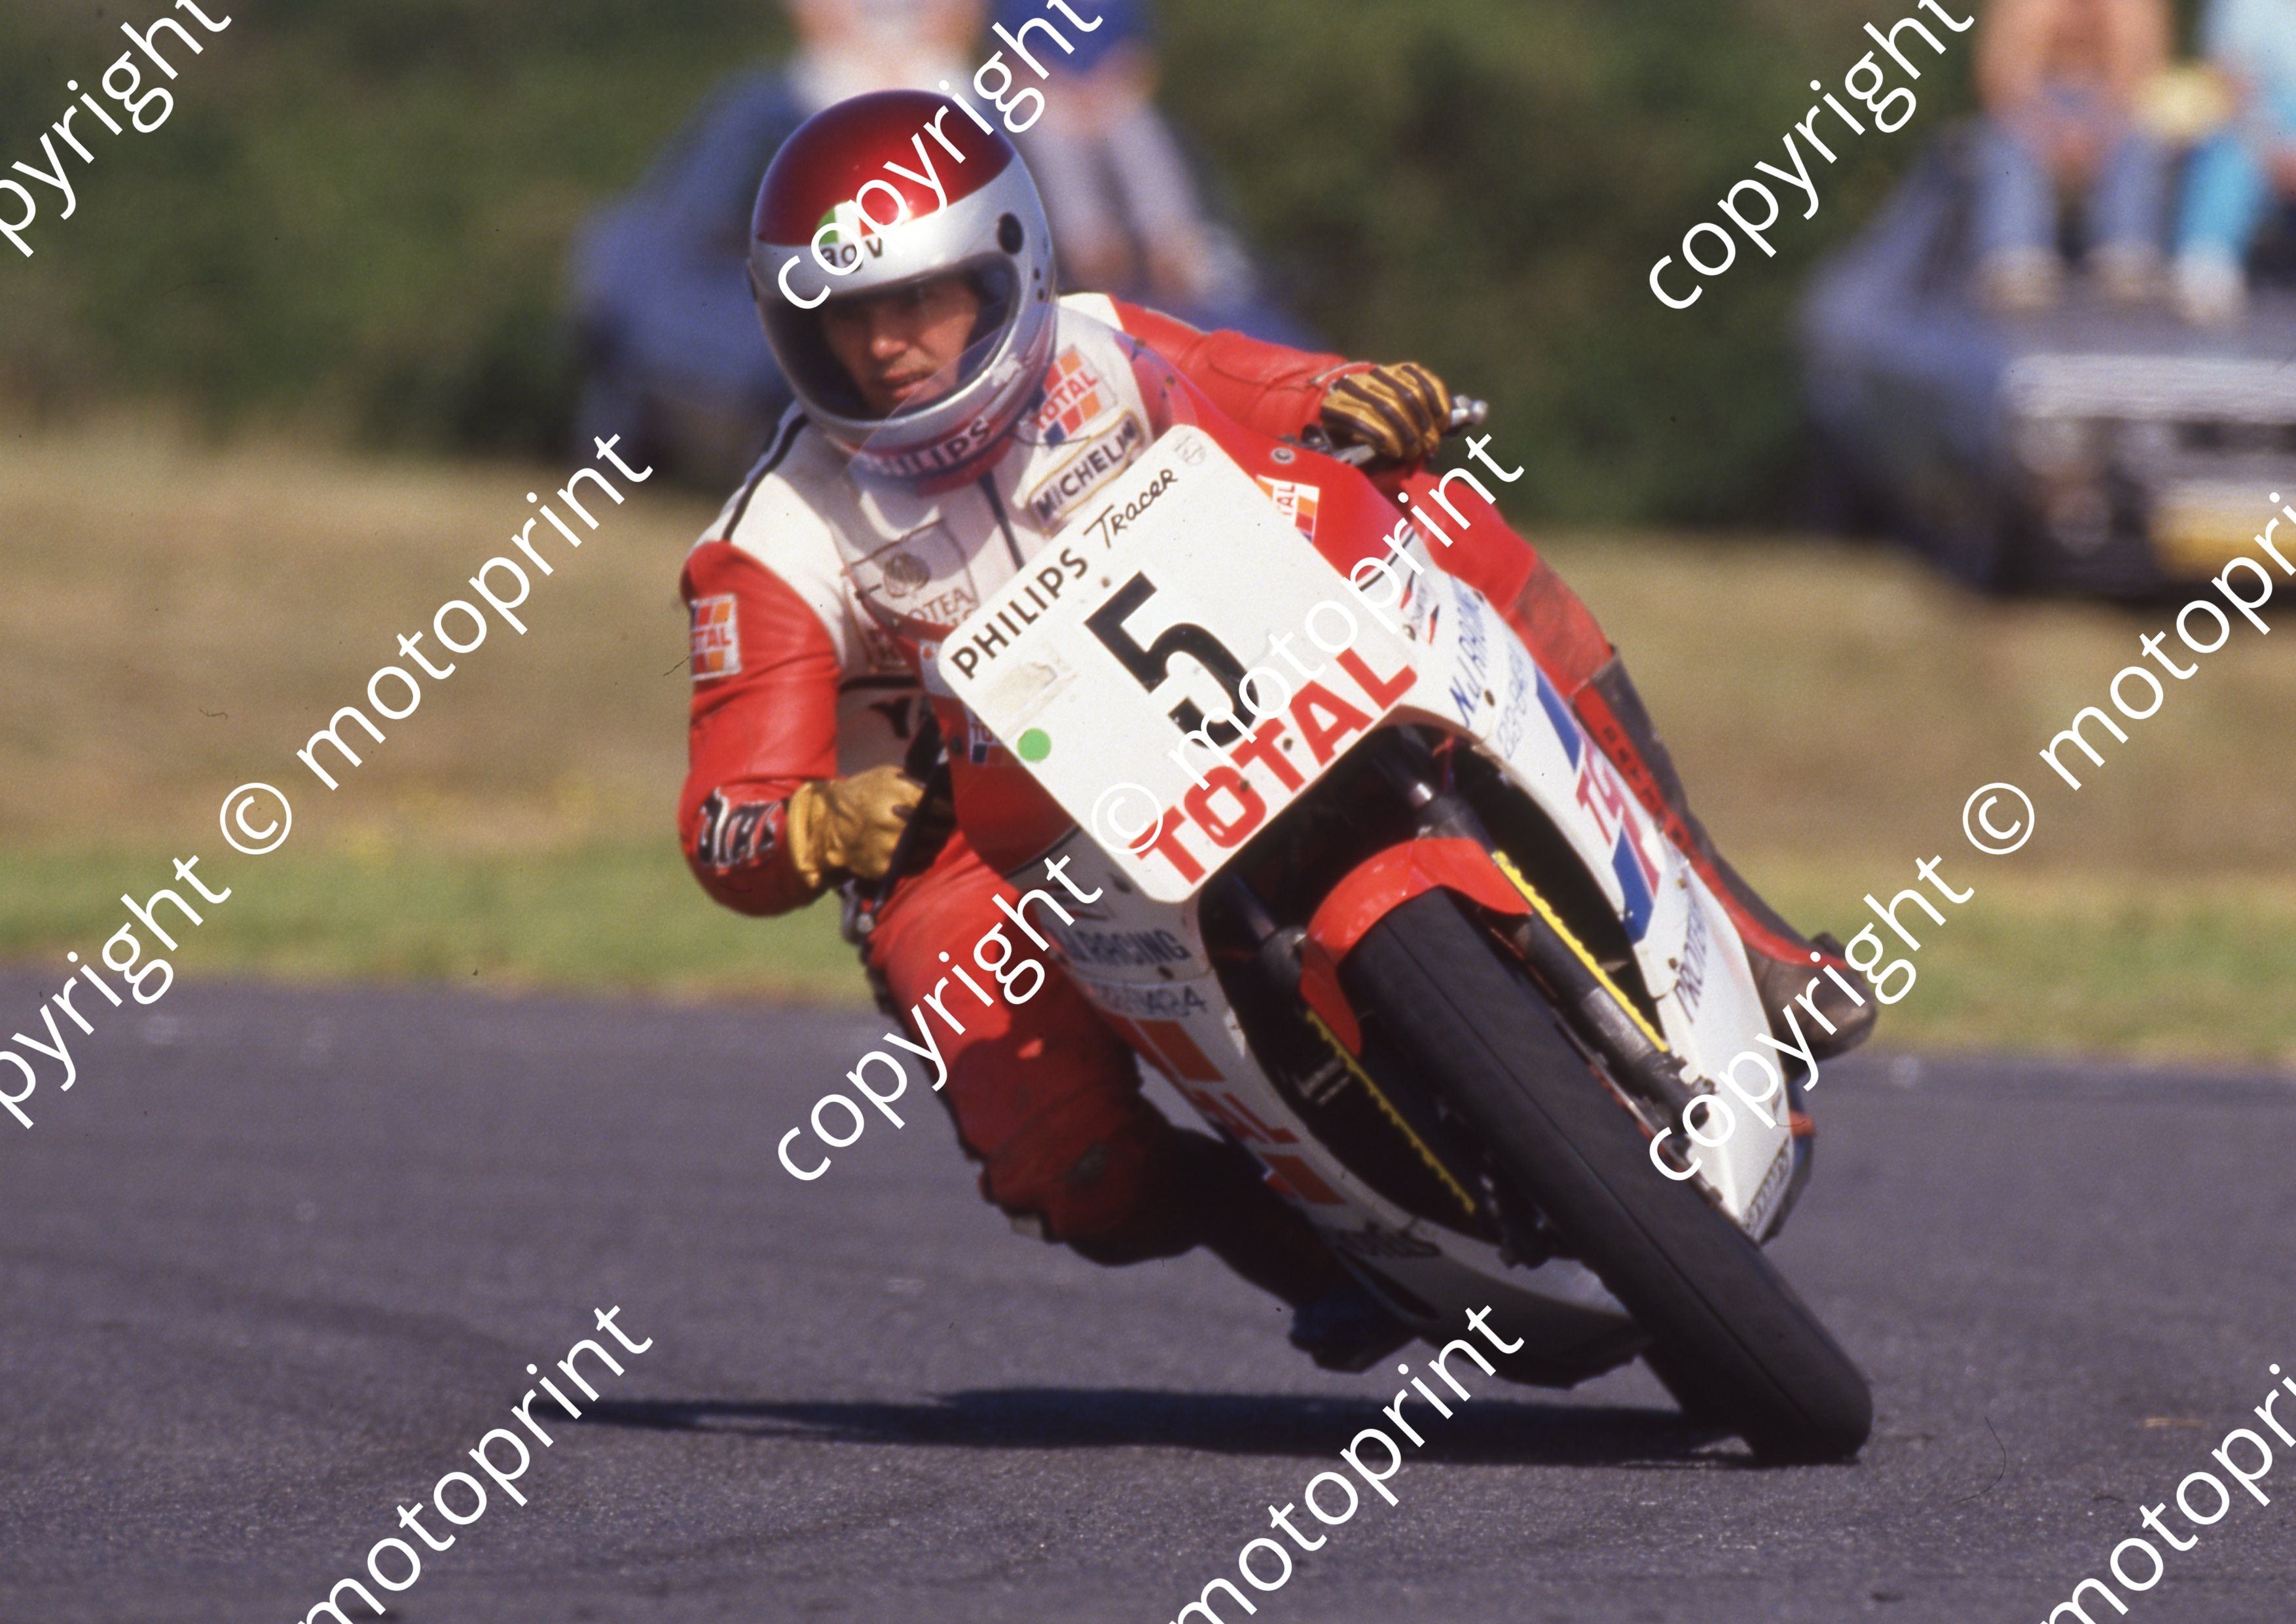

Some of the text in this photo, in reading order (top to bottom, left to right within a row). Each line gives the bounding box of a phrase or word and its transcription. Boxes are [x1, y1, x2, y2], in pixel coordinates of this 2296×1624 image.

[1030, 371, 1098, 430] TOTAL
[951, 547, 1088, 678] PHILIPS
[1084, 570, 1258, 748] 5
[1129, 647, 1417, 884] TOTAL
